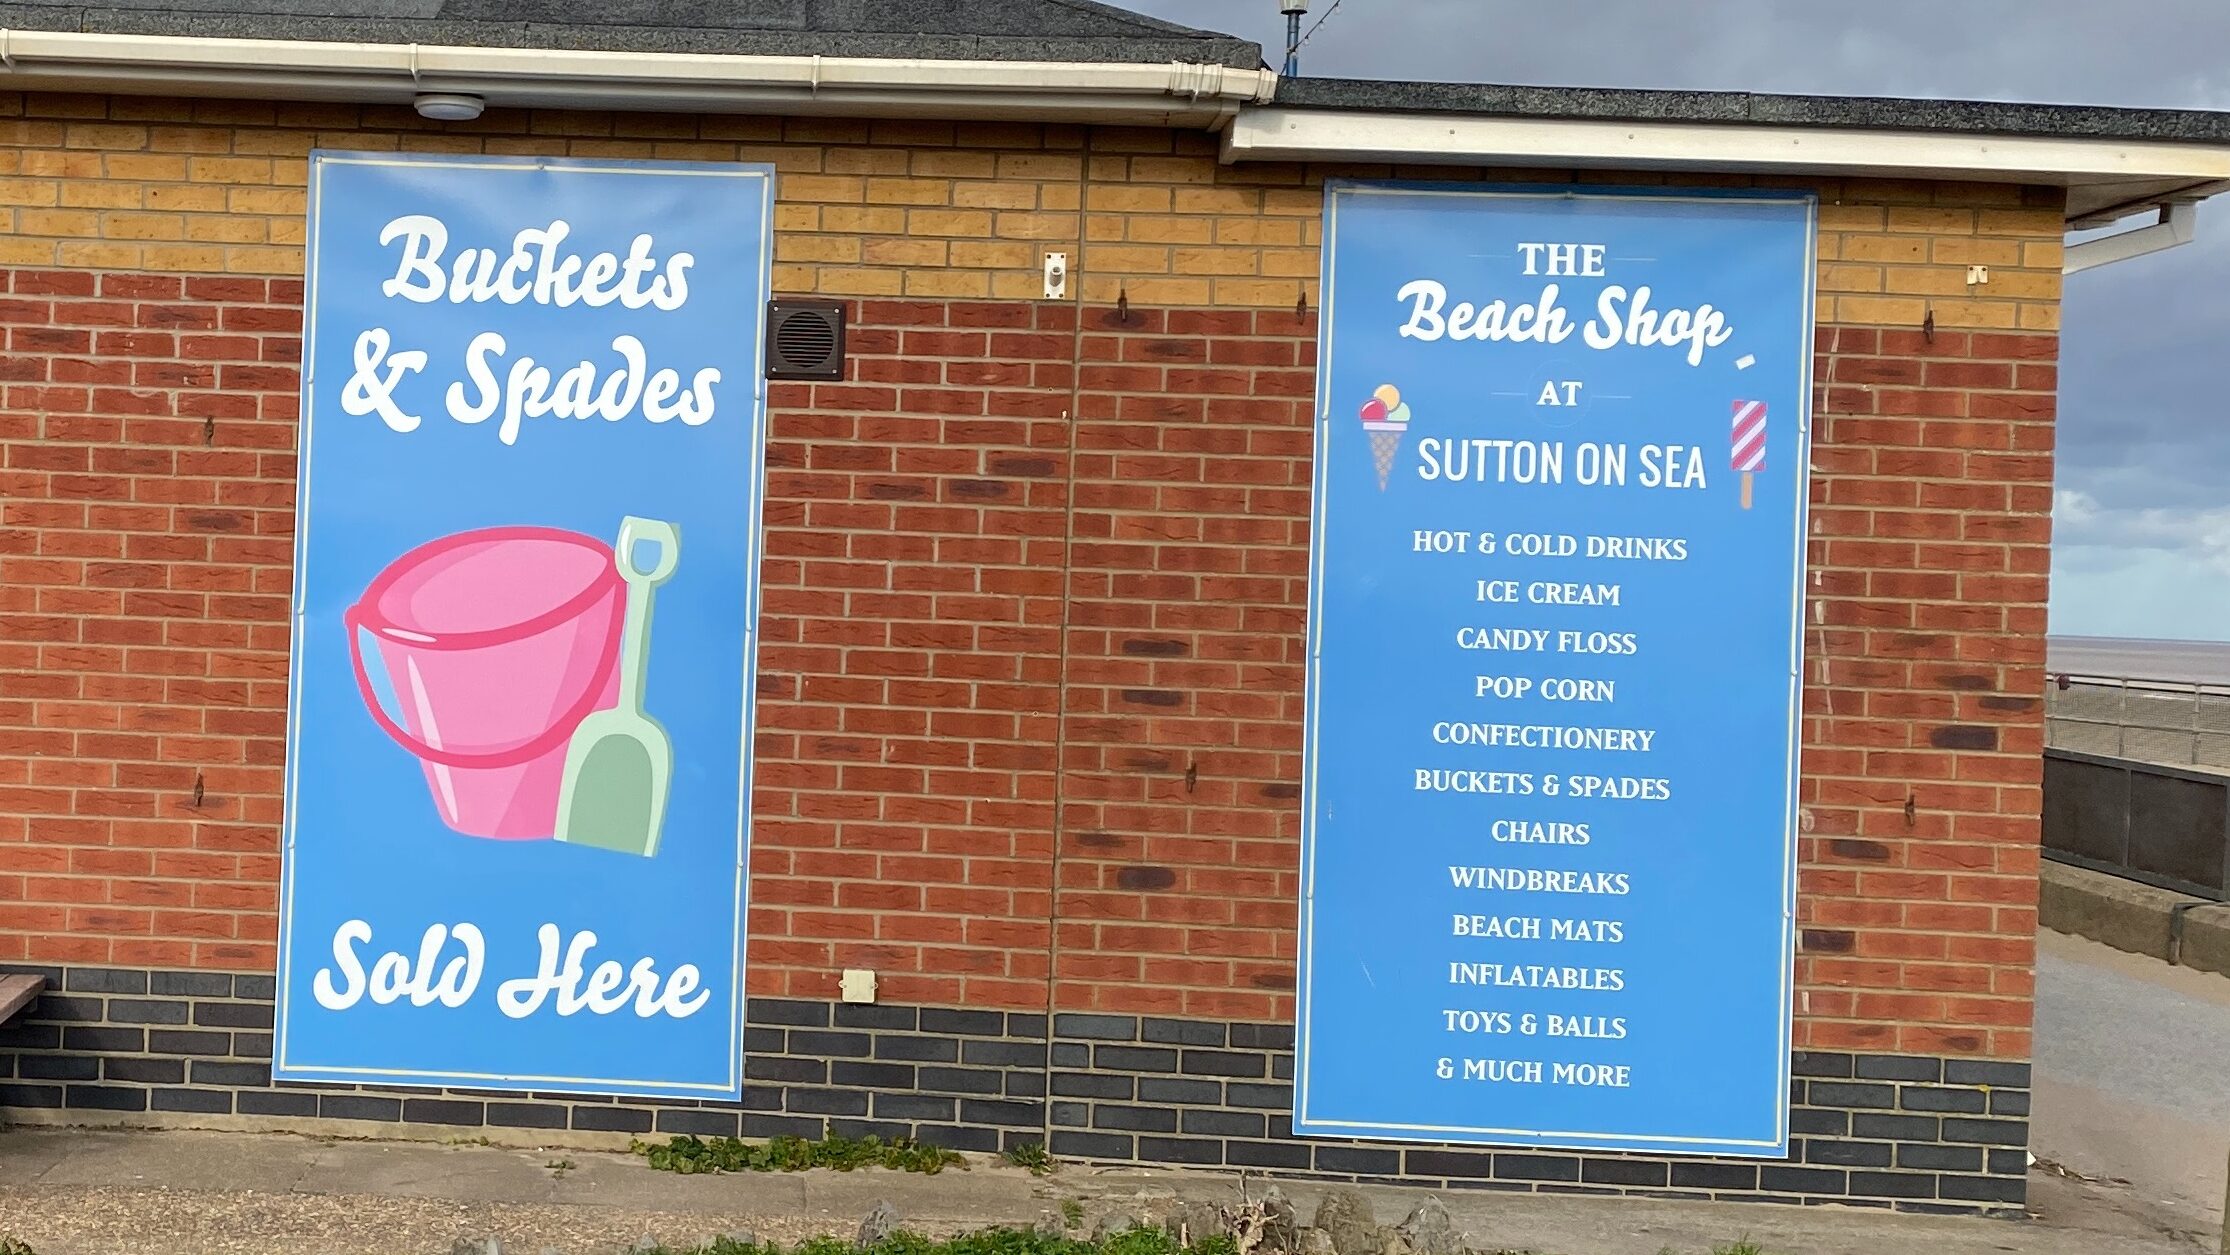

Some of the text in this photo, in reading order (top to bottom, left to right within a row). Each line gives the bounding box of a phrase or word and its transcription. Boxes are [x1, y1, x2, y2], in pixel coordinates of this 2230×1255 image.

[380, 215, 694, 310] Buckets
[1518, 243, 1605, 276] THE
[1398, 280, 1732, 366] Beach Shop
[341, 328, 721, 445] & Spades
[1537, 381, 1582, 405] AT
[1419, 438, 1706, 488] SUTTON ON SEA
[1413, 531, 1687, 560] HOT & COLD DRINKS
[1477, 581, 1620, 605] ICE CREAM
[1457, 628, 1636, 654] CANDY FLOSS
[1476, 676, 1614, 702] POP CORN
[1433, 722, 1655, 751] CONFECTIONERY
[1415, 769, 1670, 799] BUCKETS & SPADES
[1492, 821, 1590, 845] CHAIRS
[1449, 867, 1629, 894] WINDBREAKS
[1453, 915, 1623, 942] BEACH MATS
[314, 920, 710, 1018] Sold Here
[1450, 963, 1624, 990] INFLATABLES
[1443, 1010, 1626, 1038] TOYS & BALLS
[1437, 1058, 1630, 1086] & MUCH MORE
